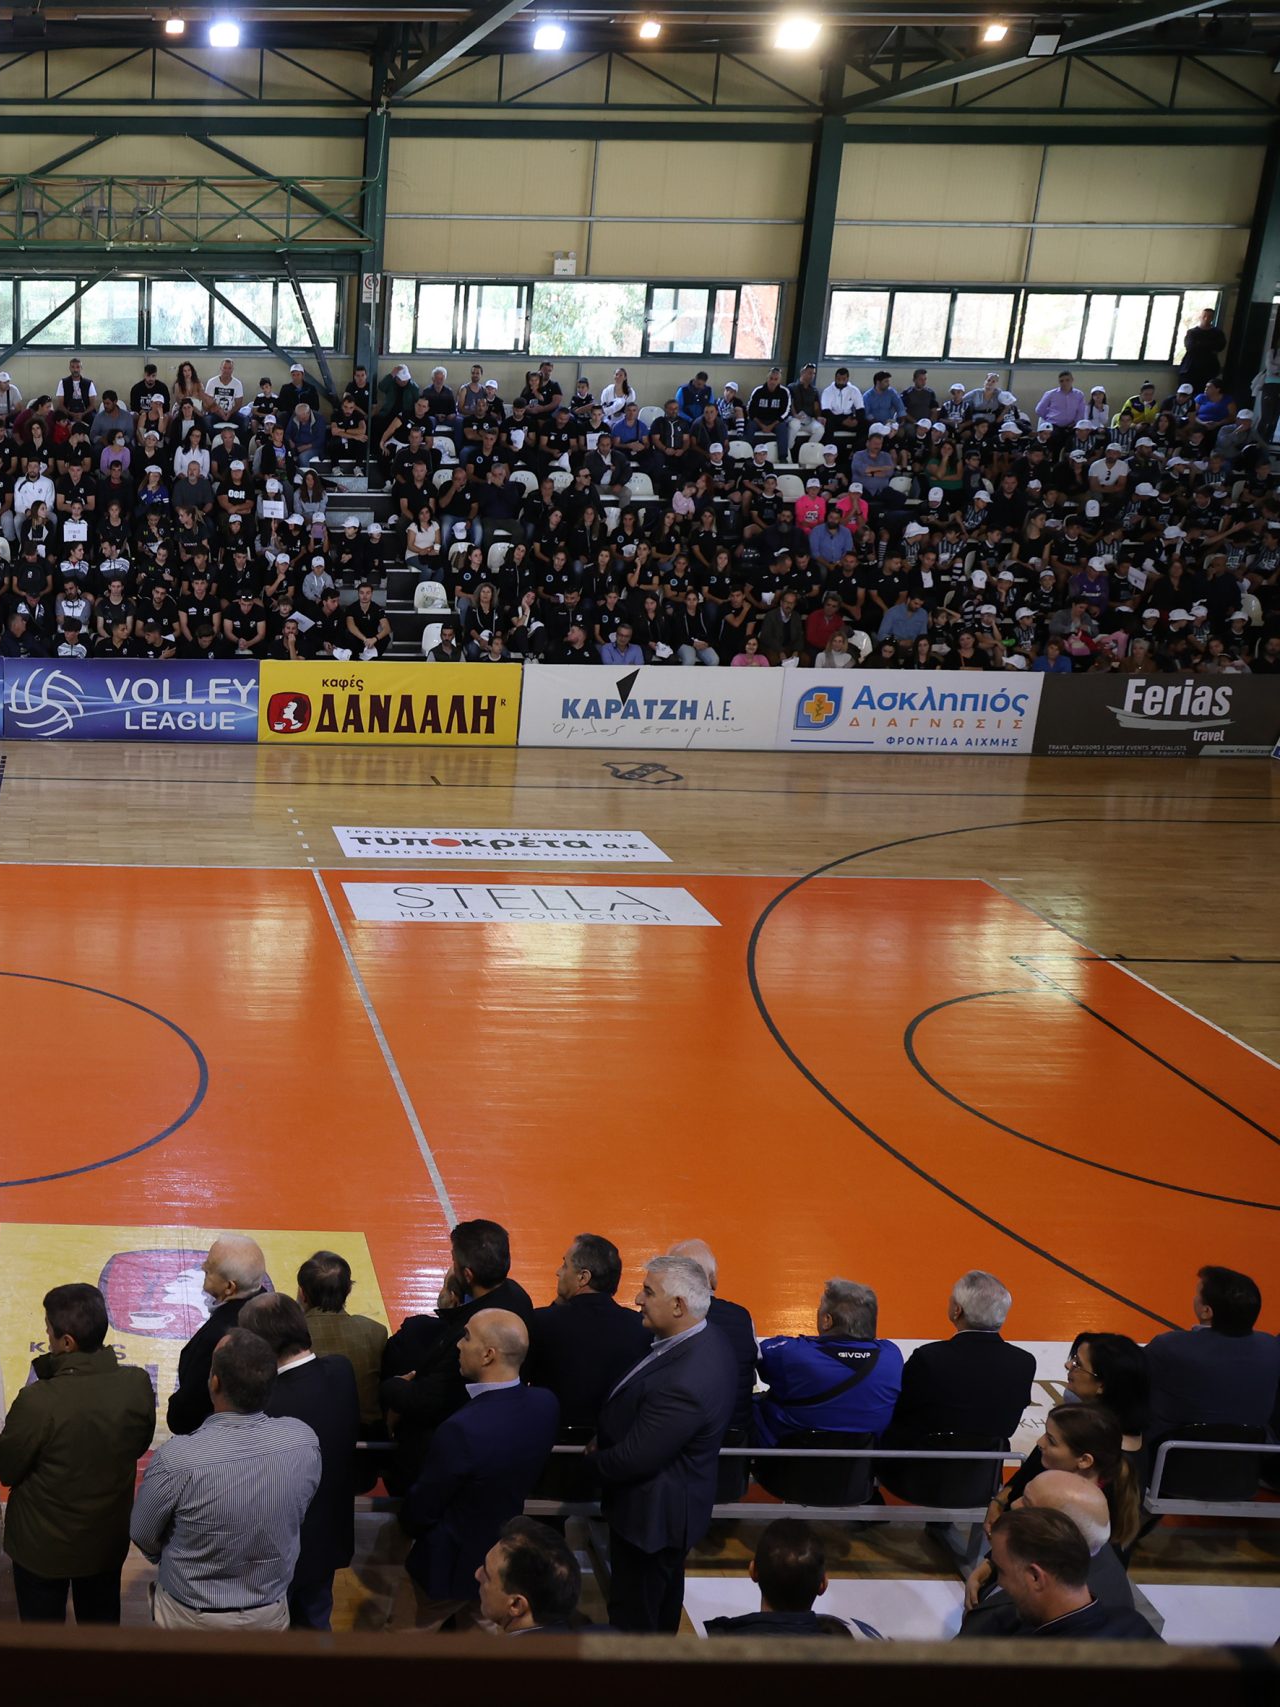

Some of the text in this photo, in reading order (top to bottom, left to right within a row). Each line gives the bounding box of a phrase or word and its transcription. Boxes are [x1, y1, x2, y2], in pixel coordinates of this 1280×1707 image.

[105, 678, 257, 704] VOLLEY
[322, 674, 364, 691] καφές
[852, 685, 1029, 716] Ασκληπιός
[1123, 678, 1233, 717] Ferias
[315, 693, 497, 734] ΔΑΝΔΑΛΗ
[561, 698, 698, 720] ΚΑΡΑΤΖΗ
[125, 711, 236, 731] LEAGUE
[849, 717, 1023, 729] ΔΙΑΓΝΩΣΙΣ
[886, 736, 1019, 748] ΦΡΟΝΤΙΔΑ ΑΙΧΜΗΣ
[1193, 729, 1225, 742] travel
[392, 886, 662, 913] STELLA
[400, 911, 673, 922] HOTELS COLLECTION
